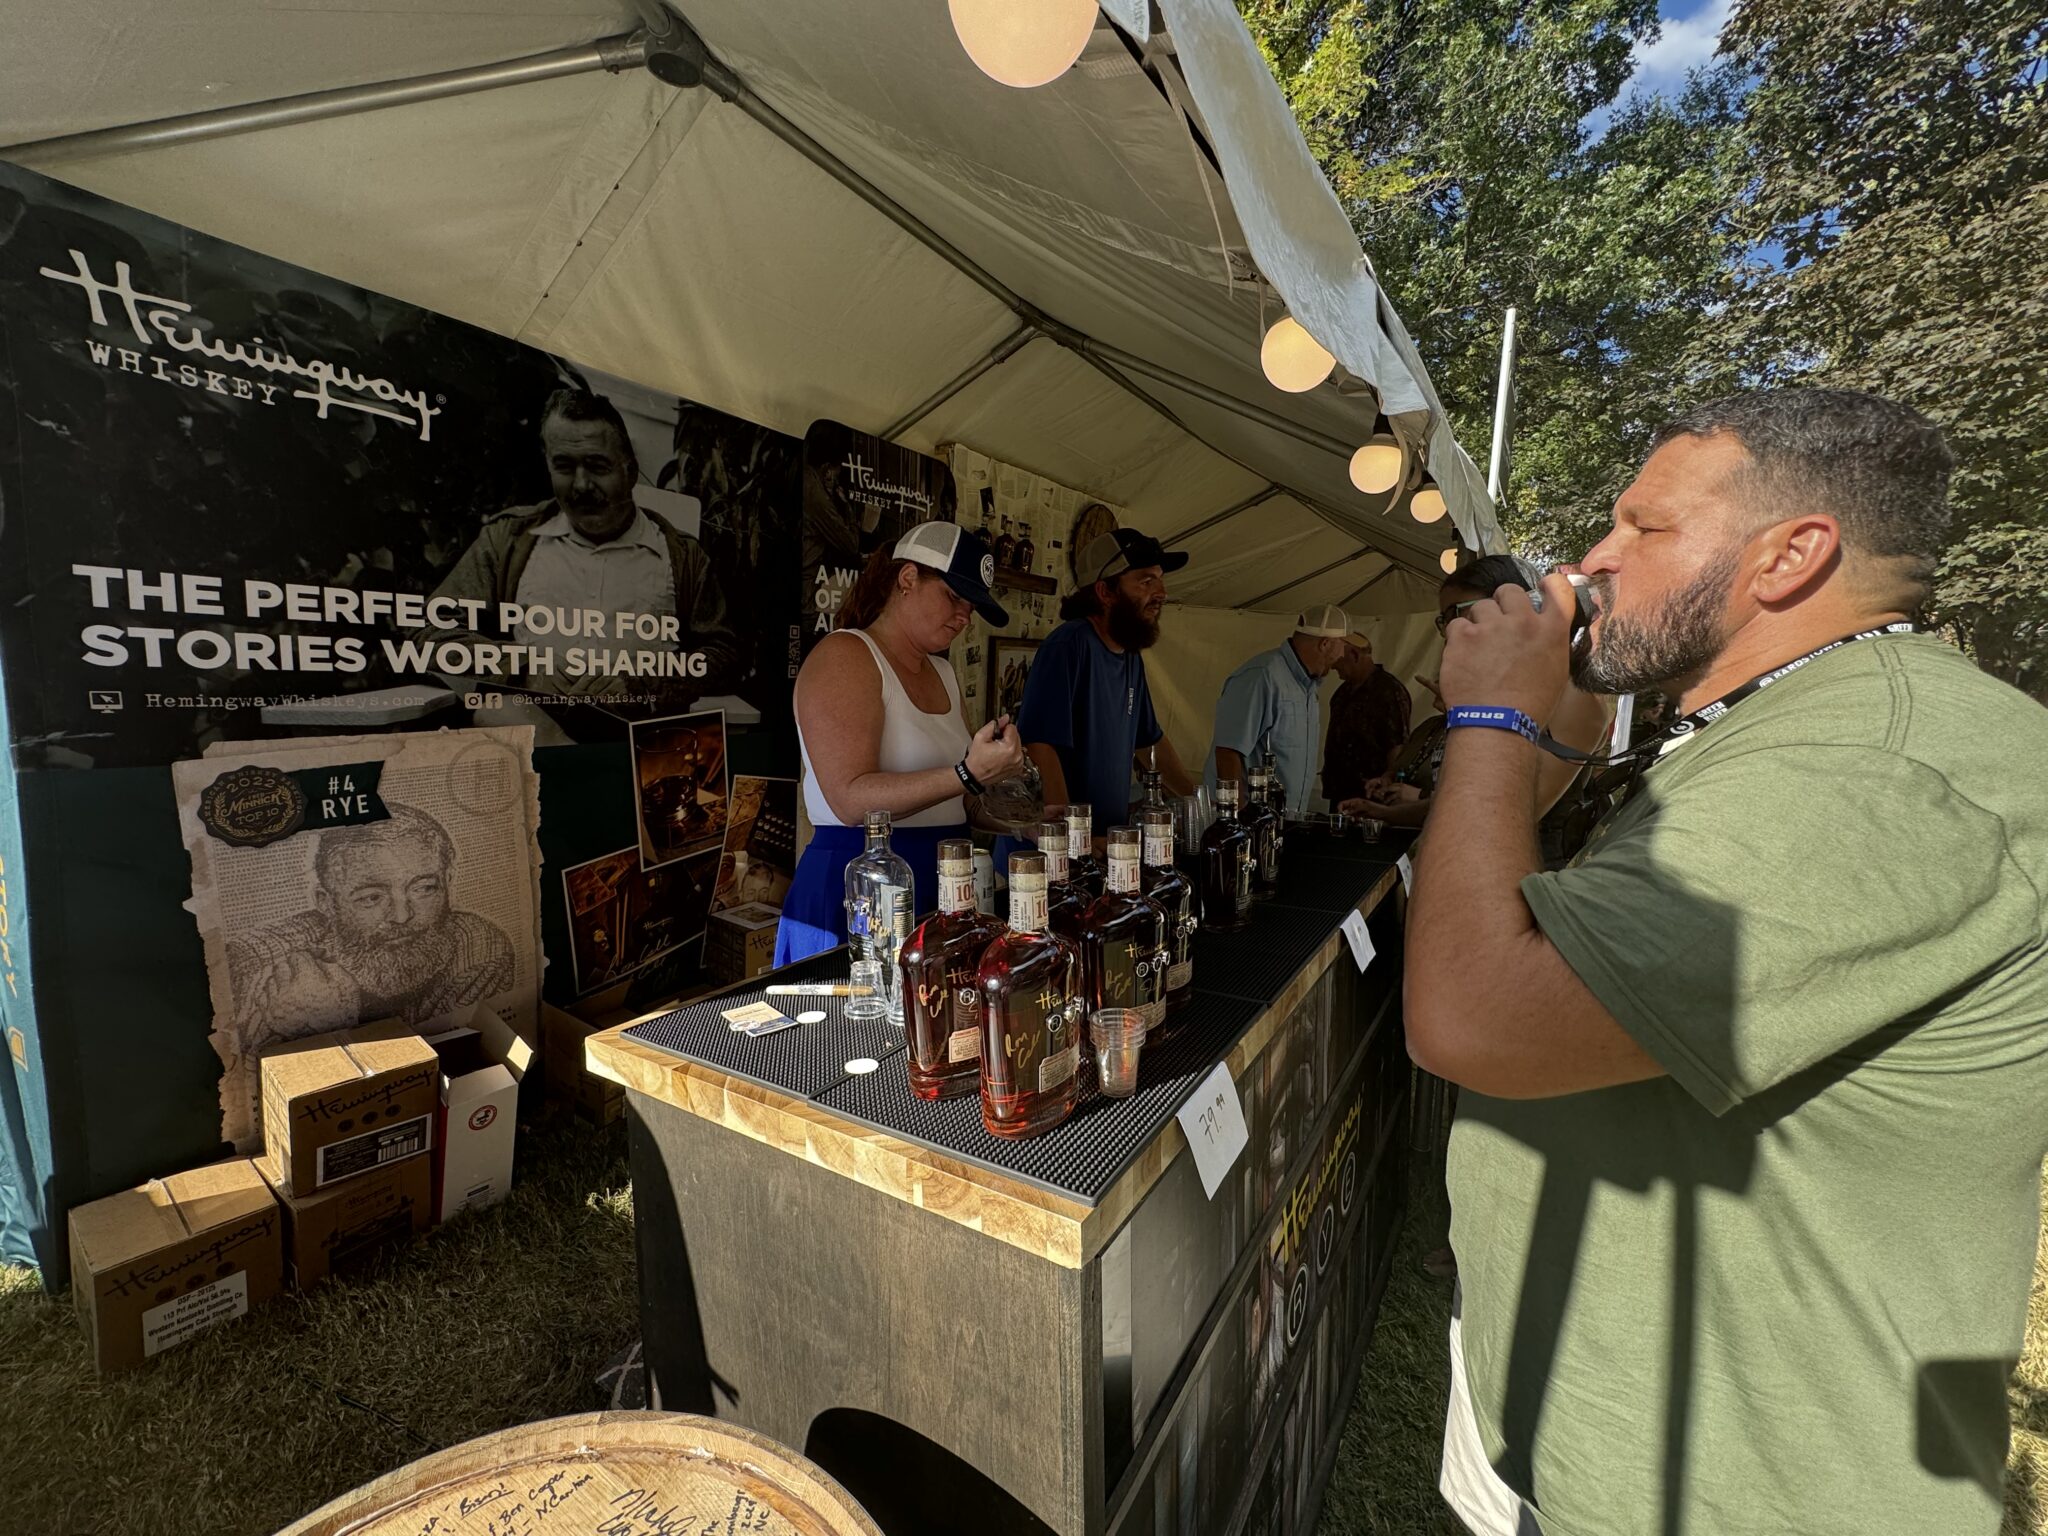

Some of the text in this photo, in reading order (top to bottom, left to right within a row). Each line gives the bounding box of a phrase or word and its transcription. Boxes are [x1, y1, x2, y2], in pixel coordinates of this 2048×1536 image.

[40, 249, 442, 441] Hemingway
[85, 339, 278, 405] WHISKEY
[849, 490, 891, 510] WHISKEY
[815, 565, 830, 585] A
[72, 563, 681, 642] THE PERFECT POUR FOR
[815, 588, 842, 609] OF
[80, 624, 707, 677] STORIES WORTH SHARING
[512, 693, 657, 706] @hemingwaywhiskeys
[1695, 701, 1727, 718] GREEN
[226, 776, 276, 793] 2022
[328, 774, 356, 795] #4
[235, 807, 280, 825] TOP 10
[321, 793, 370, 819] RYE
[298, 1069, 435, 1123] Hemingway
[104, 1213, 275, 1297] Hemingway
[148, 1321, 175, 1338] Western
[176, 1308, 206, 1325] Kentucky
